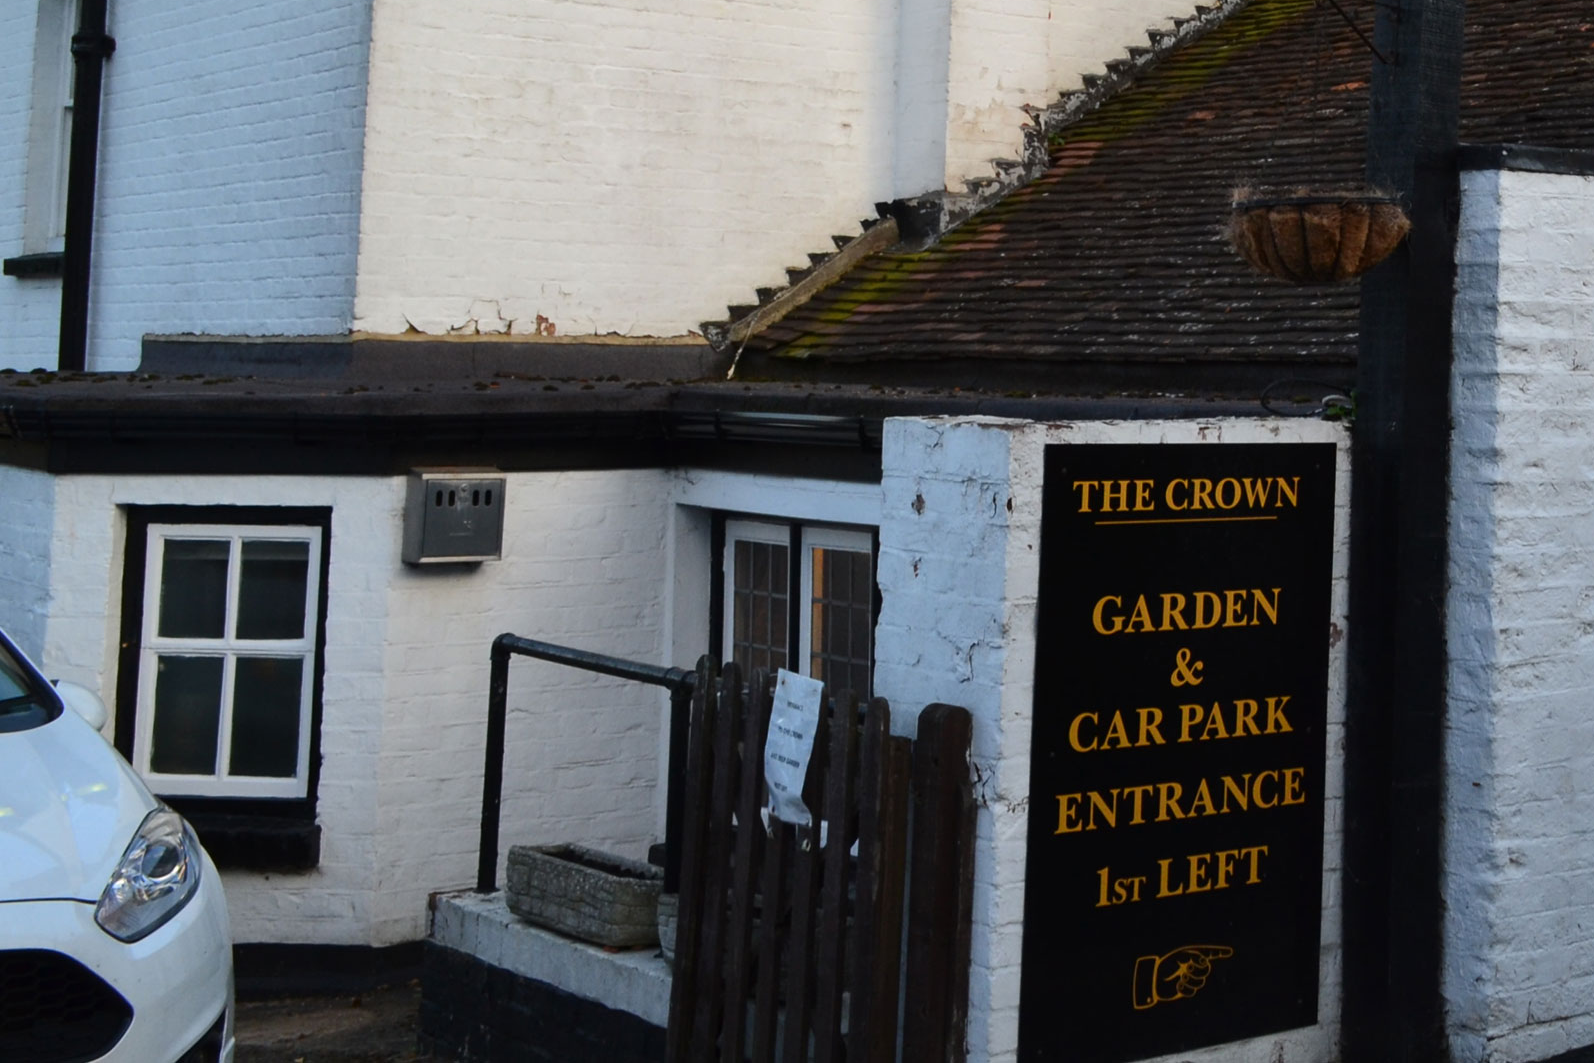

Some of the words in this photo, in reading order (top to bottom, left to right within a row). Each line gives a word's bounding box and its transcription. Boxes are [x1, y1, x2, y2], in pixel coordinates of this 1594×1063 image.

[1073, 478, 1155, 513] THE
[1165, 476, 1301, 510] CROWN
[1092, 587, 1282, 636] GARDEN
[1170, 647, 1204, 687] &
[1068, 706, 1166, 754] CAR
[1177, 695, 1294, 744] PARK
[1054, 766, 1306, 835] ENTRANCE
[1156, 845, 1269, 900] LEFT
